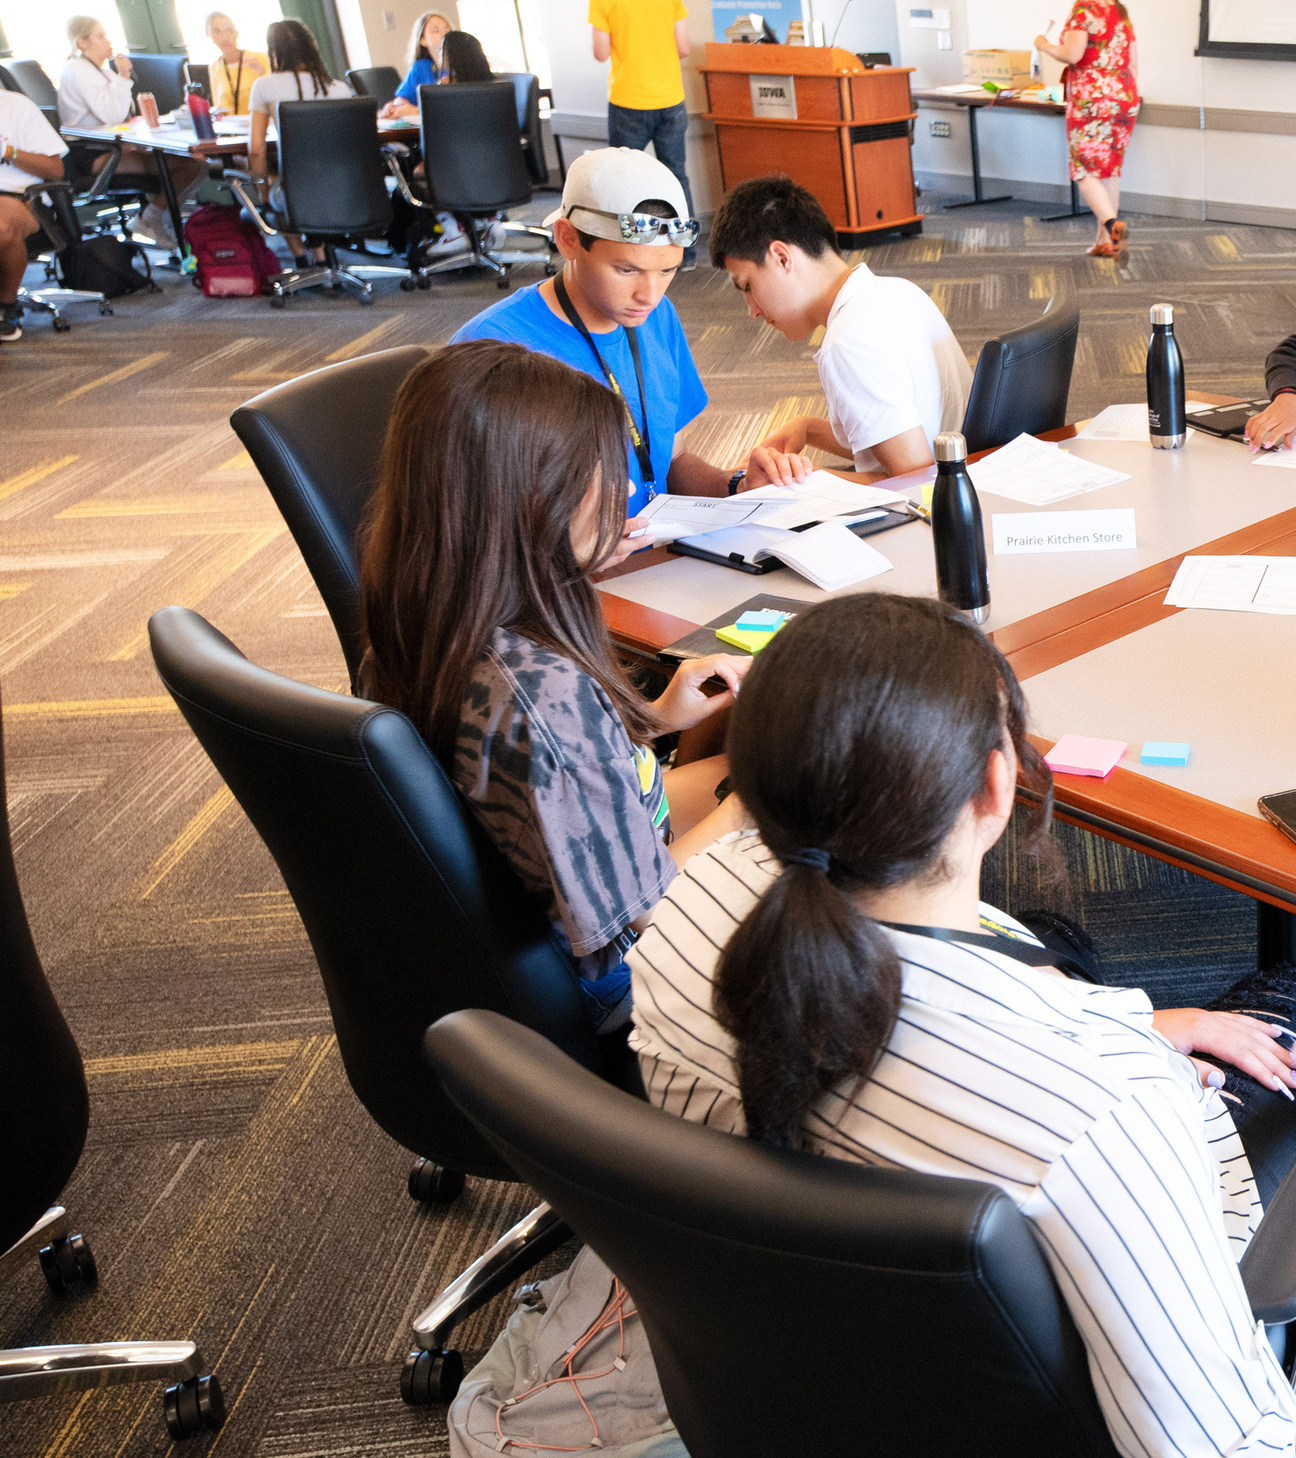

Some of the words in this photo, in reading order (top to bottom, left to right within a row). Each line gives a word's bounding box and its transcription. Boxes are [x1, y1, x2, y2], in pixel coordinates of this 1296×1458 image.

[1007, 536, 1044, 547] Prairie
[1047, 534, 1090, 545] Kitchen
[1093, 532, 1123, 543] Store
